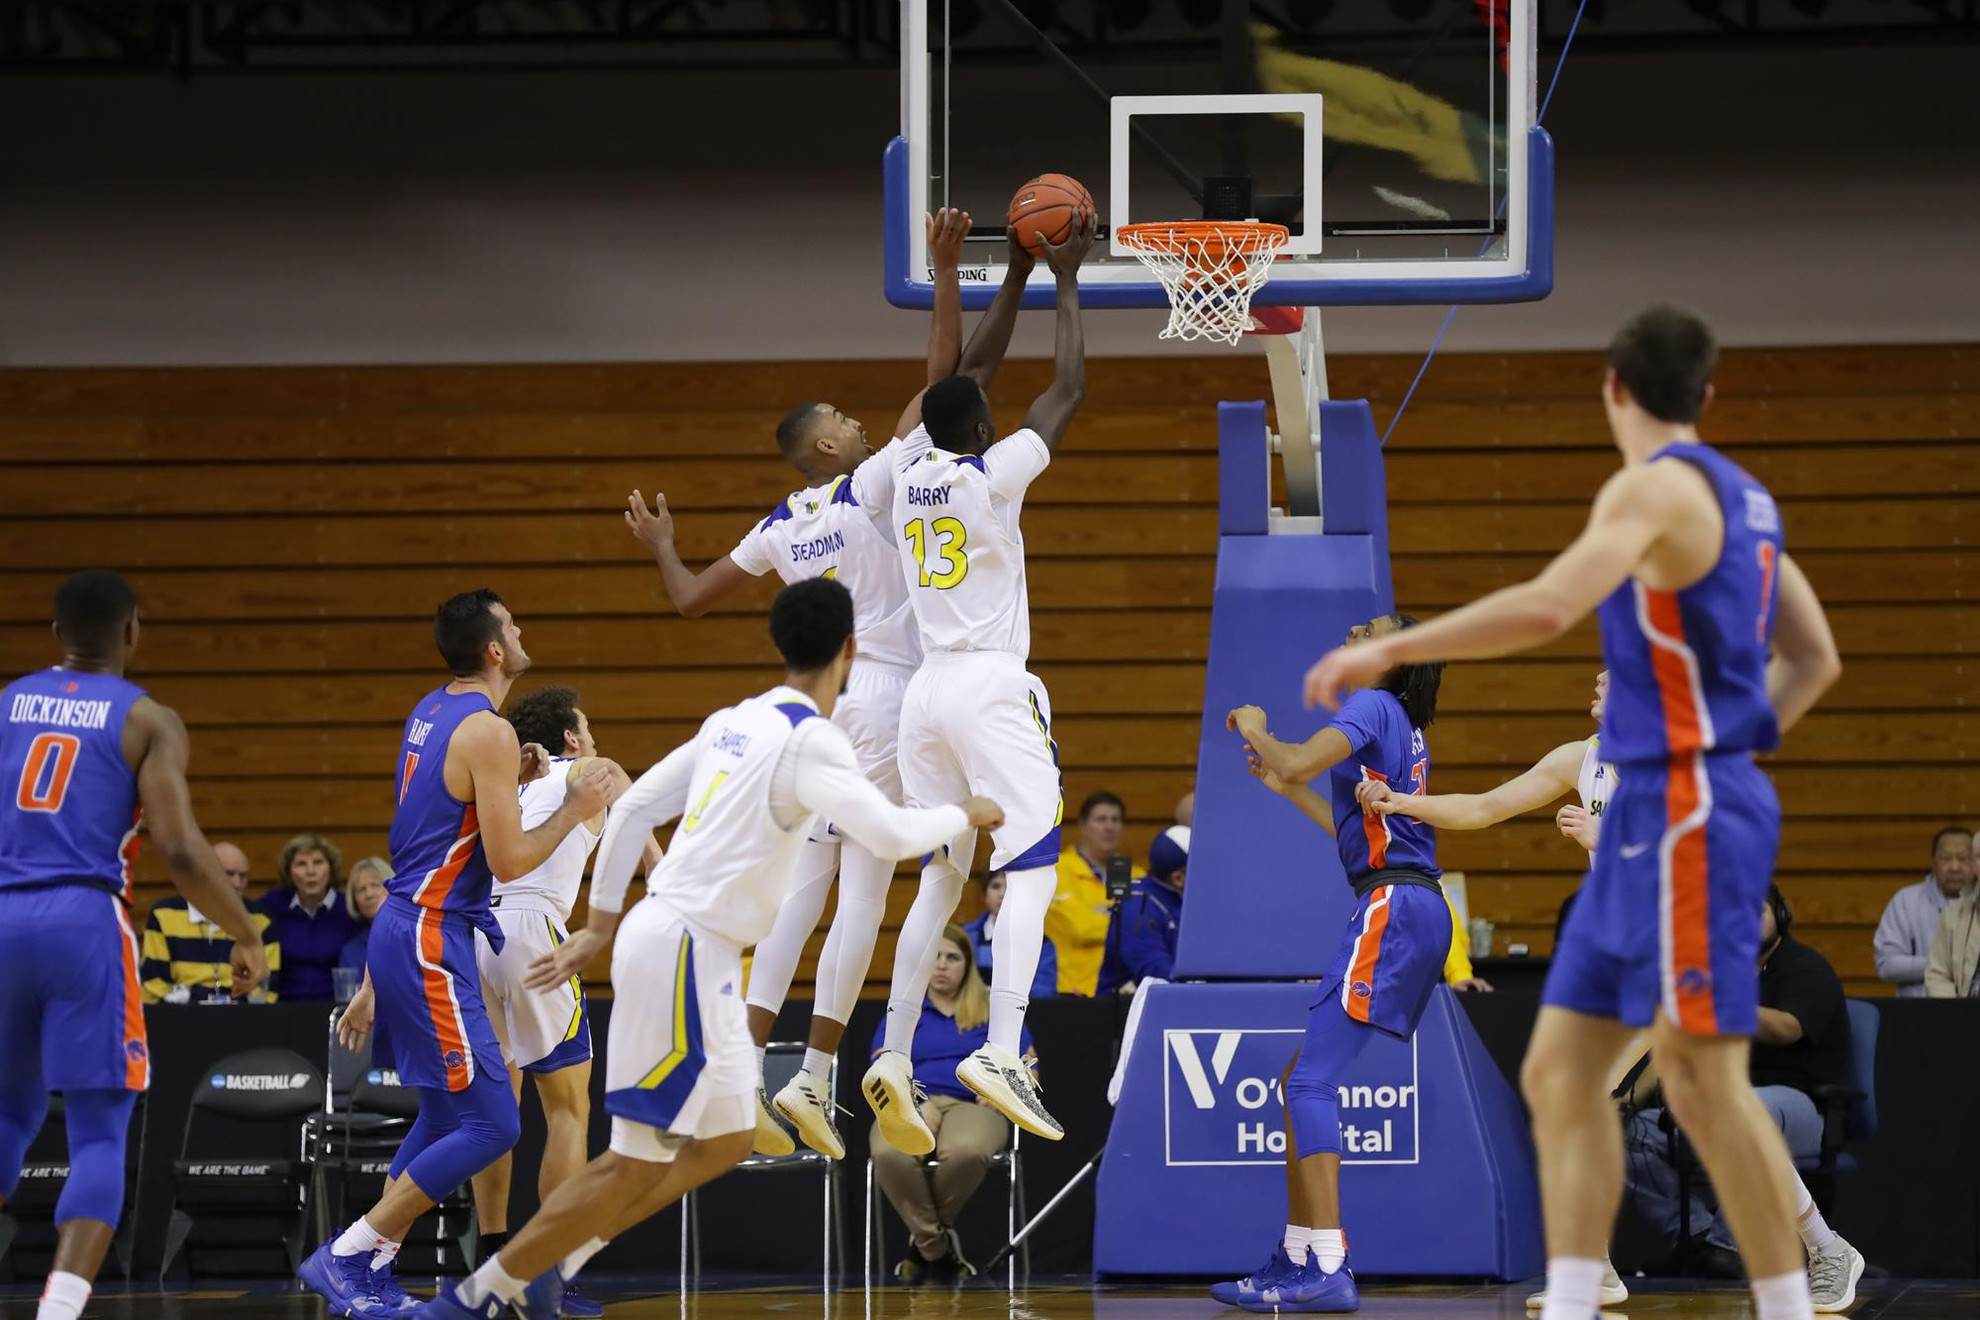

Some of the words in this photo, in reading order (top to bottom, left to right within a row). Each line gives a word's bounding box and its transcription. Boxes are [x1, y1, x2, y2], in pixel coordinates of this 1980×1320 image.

[928, 268, 987, 282] SDING
[908, 485, 951, 506] BARRY
[904, 516, 968, 590] 13
[9, 693, 111, 729] DICKINSON
[16, 732, 80, 814] 0
[226, 1074, 291, 1090] BASKETBALL
[1236, 1077, 1415, 1109] O'nnor
[31, 1168, 51, 1178] ARE
[52, 1167, 70, 1177] THE
[188, 1165, 203, 1175] WE
[203, 1165, 222, 1175] ARE
[223, 1165, 240, 1175] THE
[241, 1165, 267, 1175] GAME
[361, 1163, 375, 1173] WE
